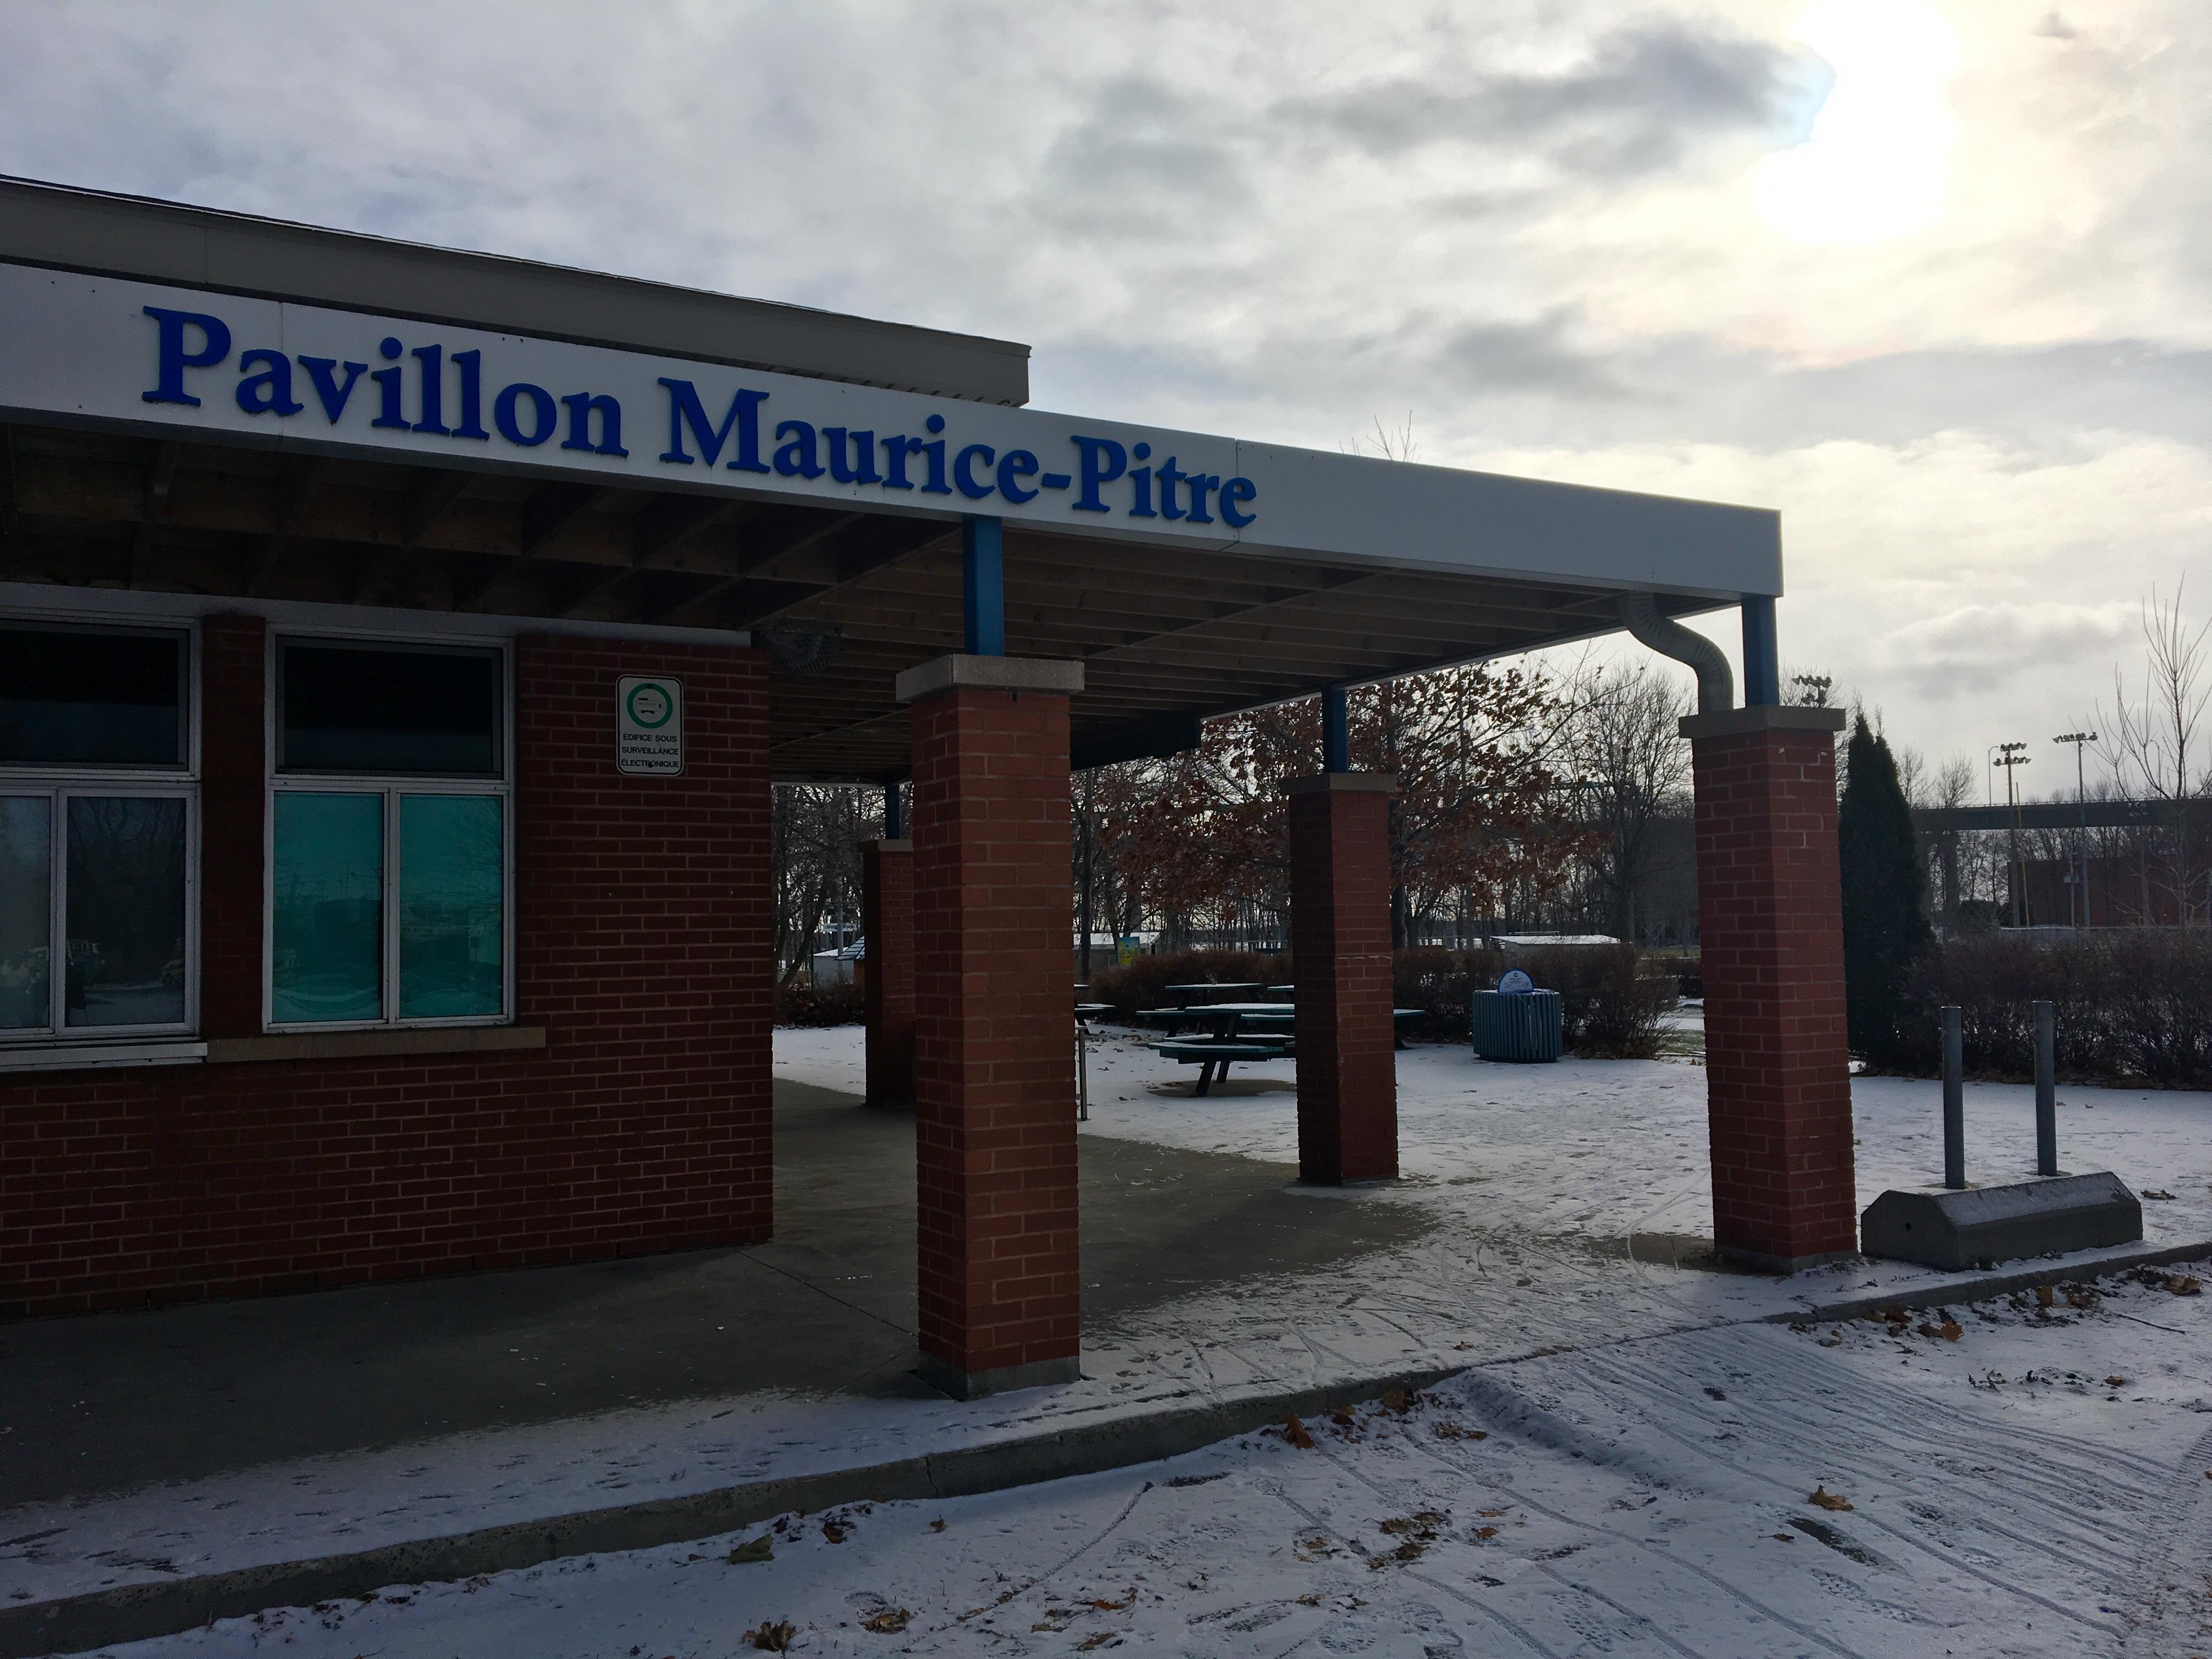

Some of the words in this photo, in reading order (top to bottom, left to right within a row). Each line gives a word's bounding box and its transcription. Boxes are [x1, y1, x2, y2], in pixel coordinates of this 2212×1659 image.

[142, 306, 629, 458] Pavillon
[658, 376, 1257, 528] Maurice-Pitre
[623, 732, 652, 741] ÉDIFICE
[622, 747, 678, 755] SURVEILLANCE
[621, 758, 679, 768] ÉLECTRONIQUE
